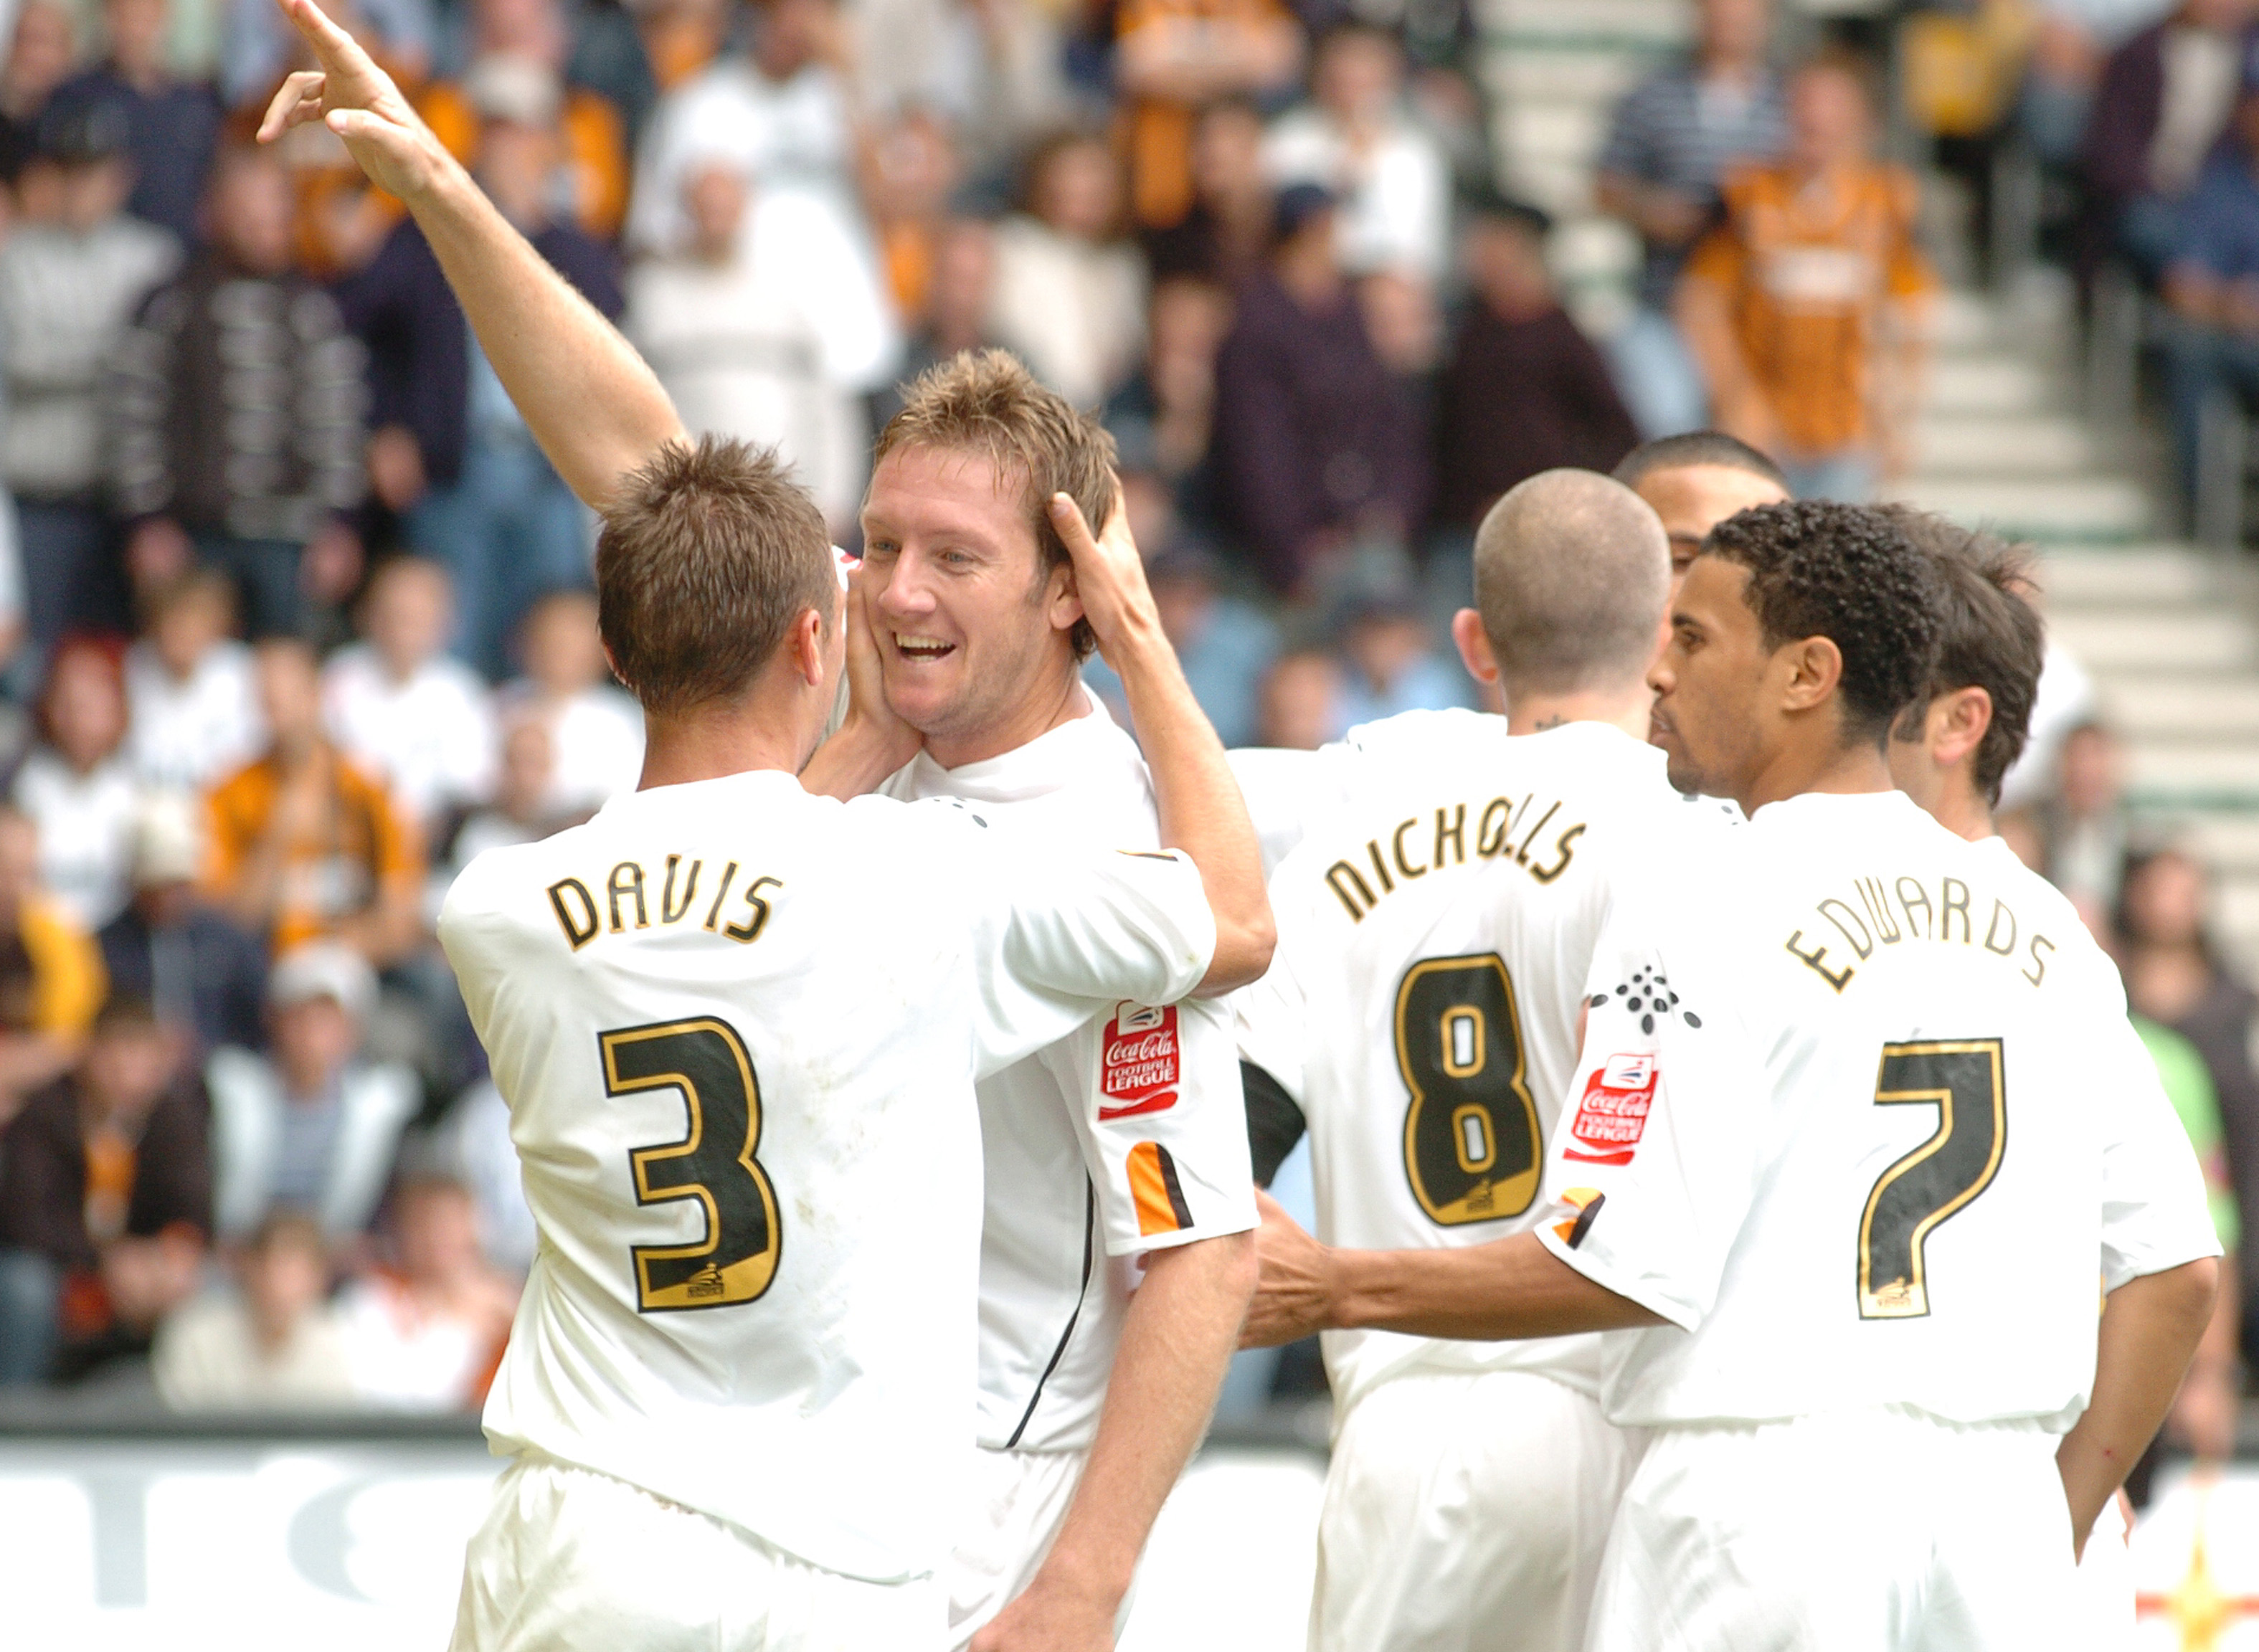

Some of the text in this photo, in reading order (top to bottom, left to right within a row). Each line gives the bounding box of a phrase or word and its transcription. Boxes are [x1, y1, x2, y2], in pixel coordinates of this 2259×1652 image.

[546, 853, 784, 953] DAVIS
[1785, 875, 2056, 995] EDWARDS
[597, 1015, 782, 1313] 3
[1107, 1067, 1175, 1093] LEAGUE
[1394, 952, 1543, 1226] 8
[1856, 1037, 2009, 1320] 7
